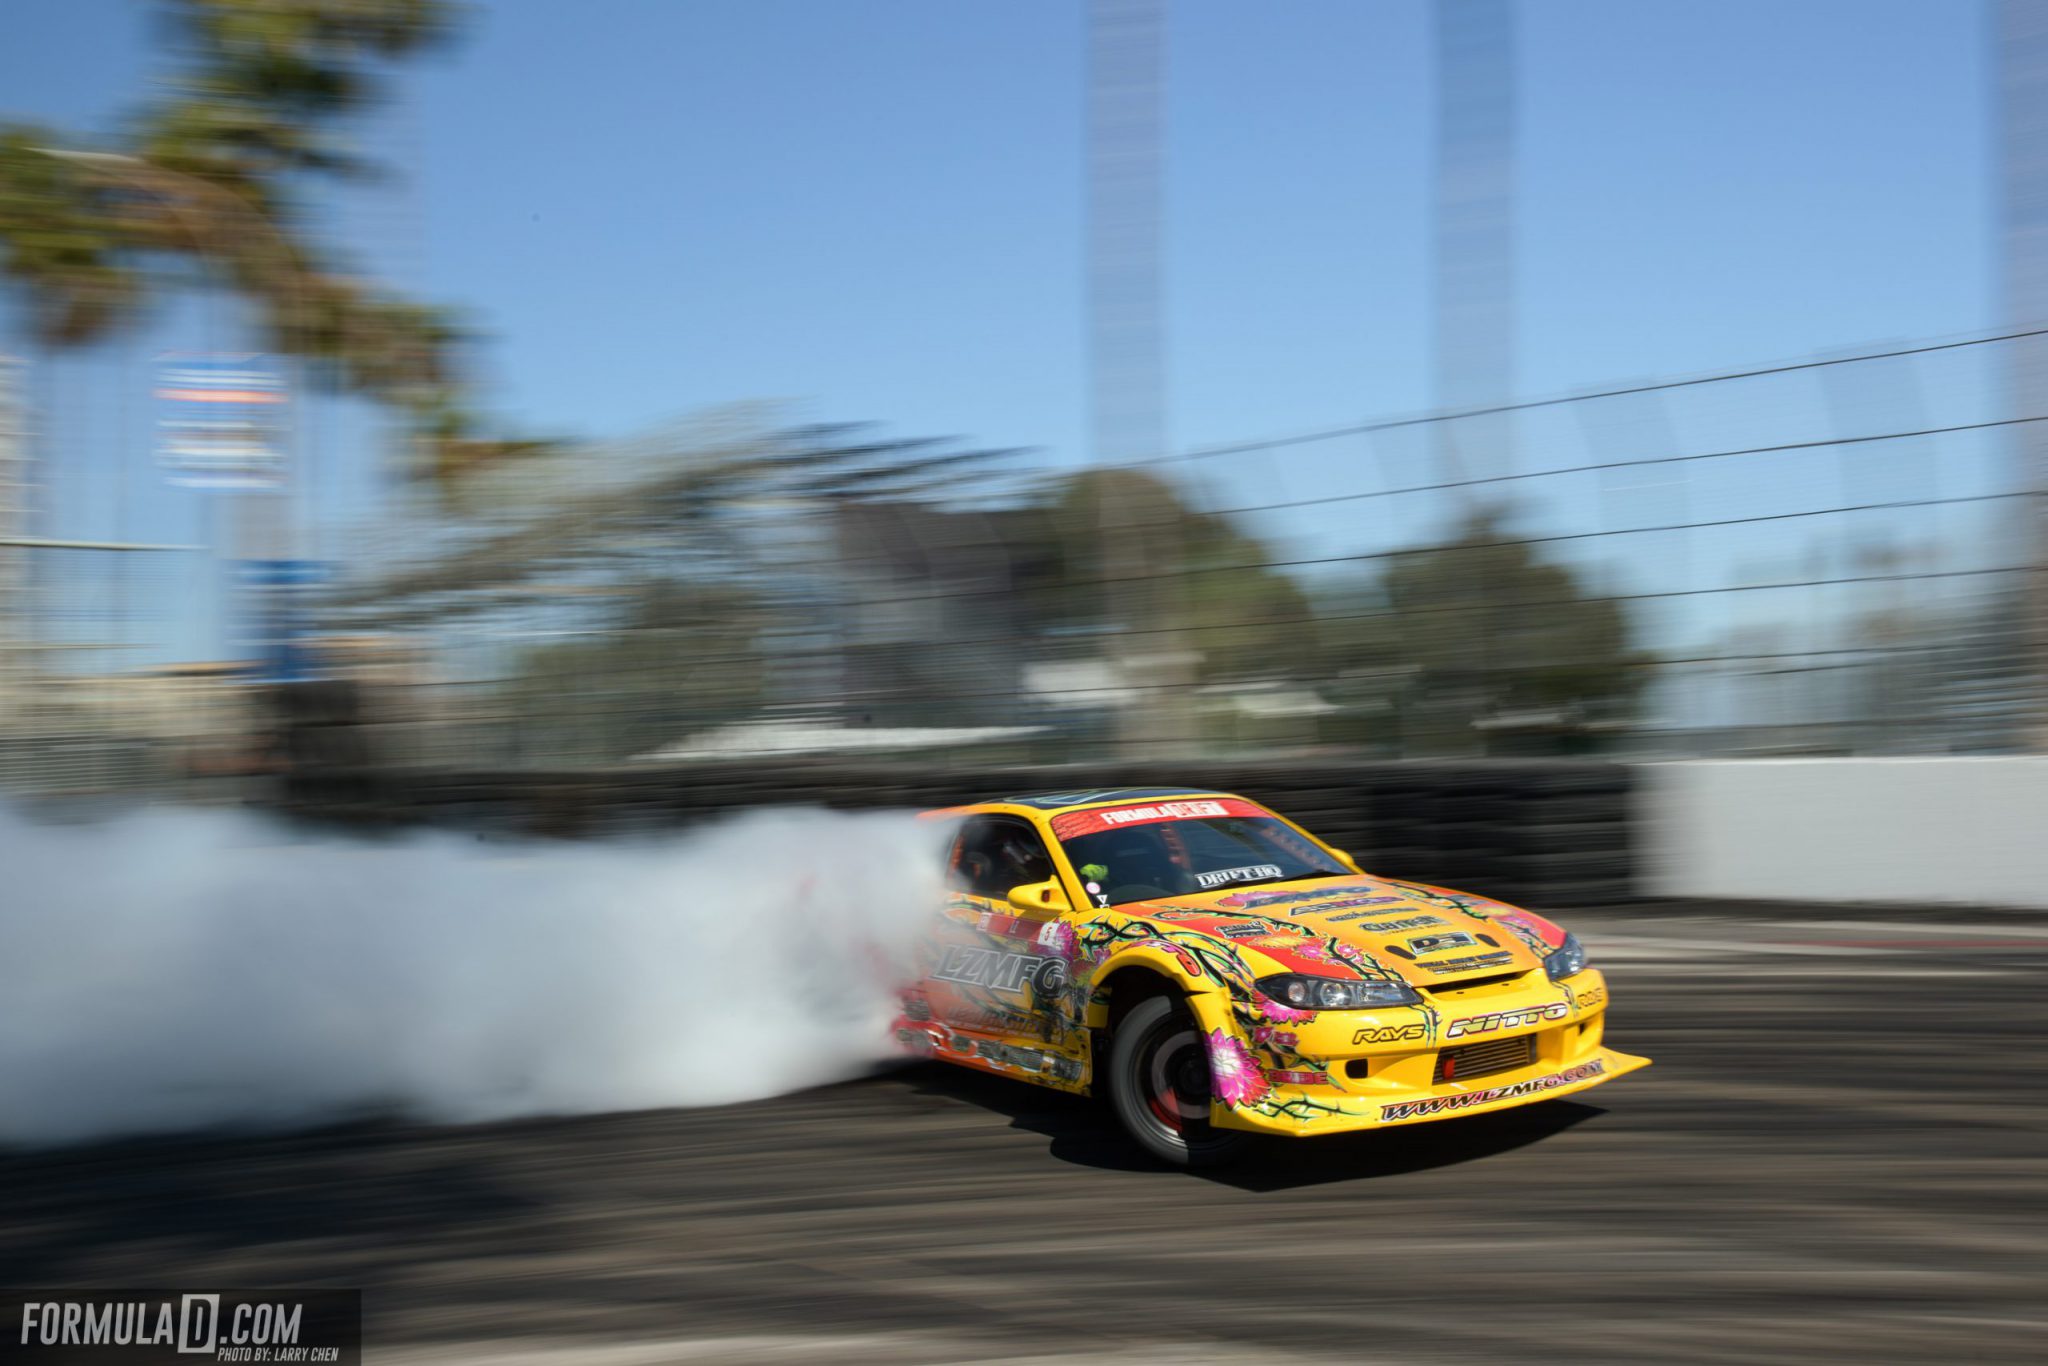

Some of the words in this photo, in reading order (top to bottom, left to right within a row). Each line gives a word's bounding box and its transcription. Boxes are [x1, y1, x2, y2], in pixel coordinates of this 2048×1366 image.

[932, 945, 1068, 998] LZMFG
[1352, 1024, 1425, 1045] RAYS
[1447, 1003, 1569, 1039] NITTO
[1381, 1059, 1605, 1122] WWW.LZMFG.COM
